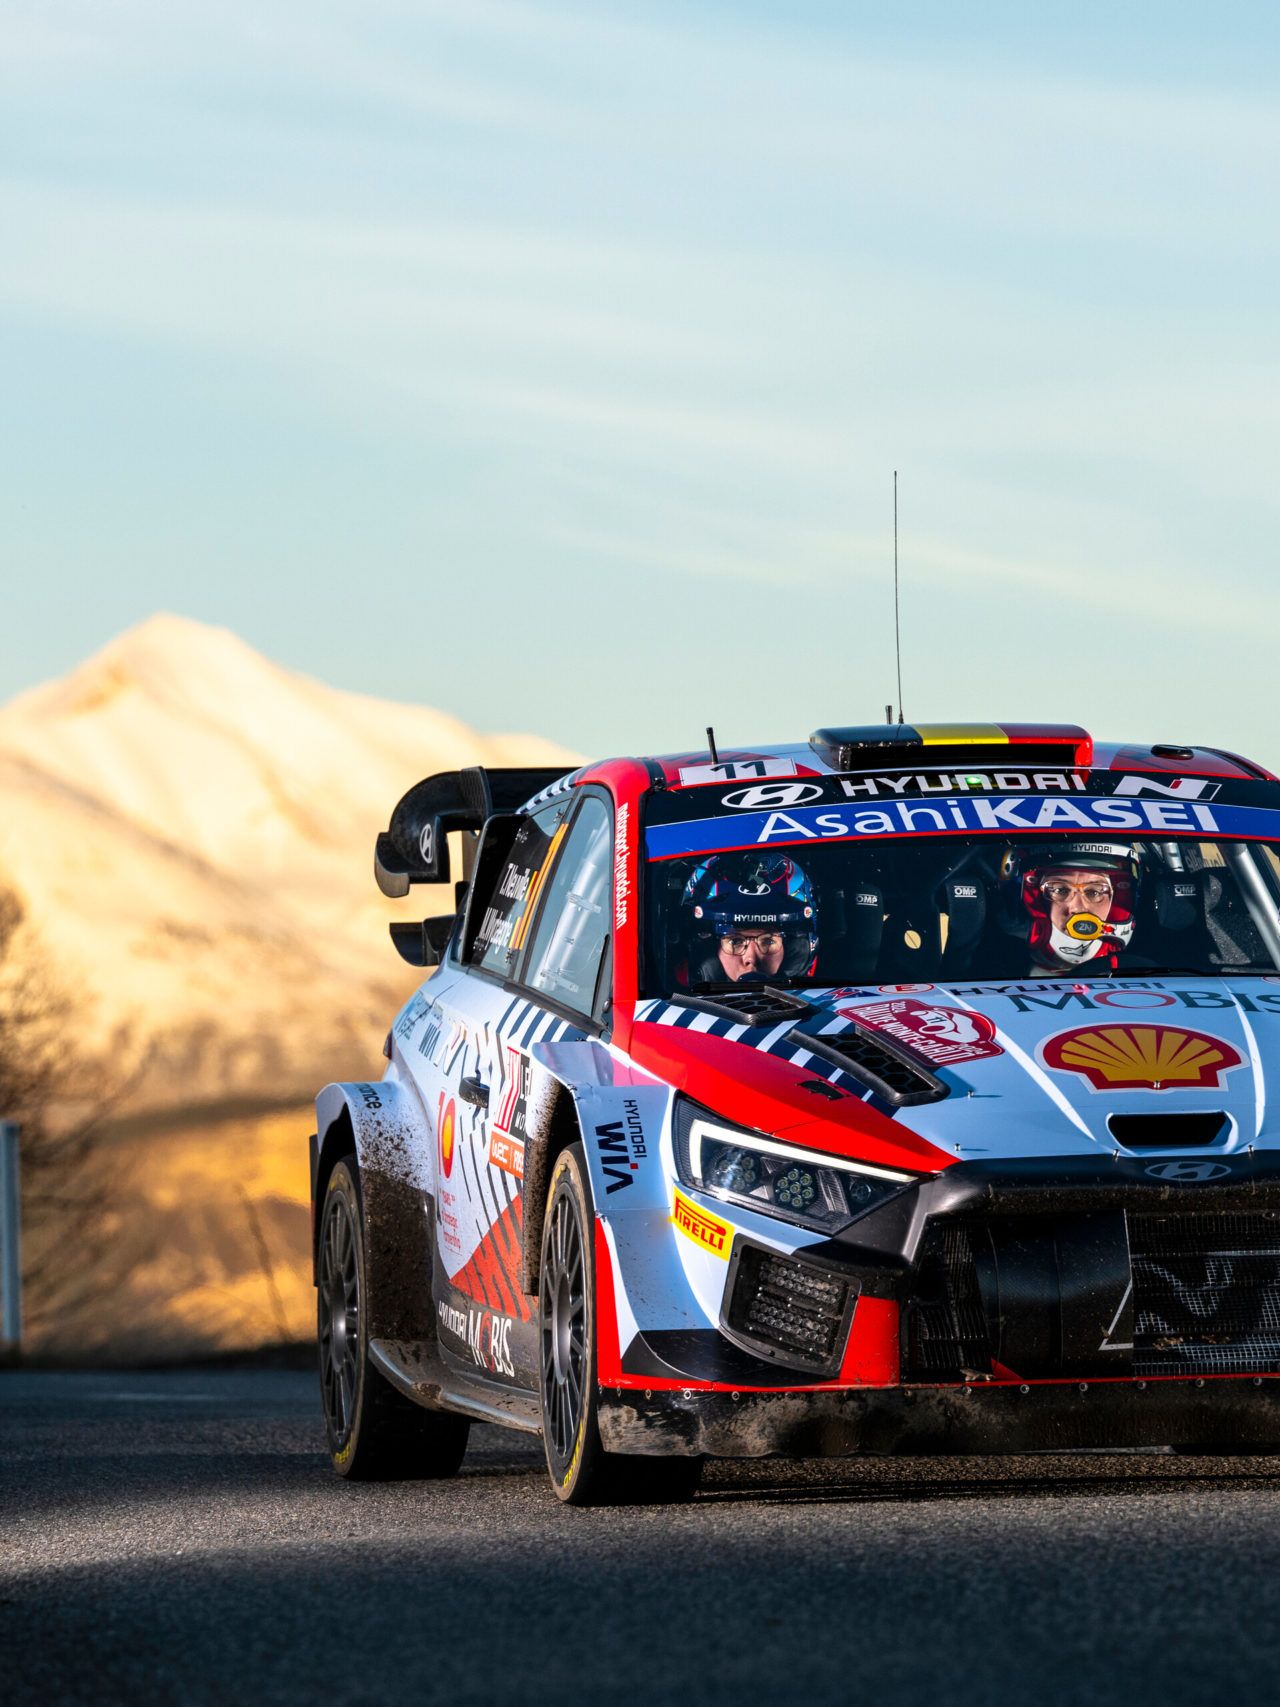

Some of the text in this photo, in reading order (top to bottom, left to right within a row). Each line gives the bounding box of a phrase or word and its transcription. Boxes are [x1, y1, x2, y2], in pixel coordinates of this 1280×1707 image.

[710, 760, 767, 779] 11
[840, 774, 1086, 796] HYUNDAI
[1072, 844, 1112, 853] HYUNDAI
[615, 803, 631, 930] motorsport.hyundai.com
[856, 895, 878, 904] OMP
[955, 888, 977, 896] OMP
[734, 914, 777, 922] HYUNDAI
[950, 982, 1166, 996] HYUNDAI
[624, 1100, 647, 1158] HYUNDAI
[595, 1121, 634, 1195] WIA
[674, 1197, 727, 1251] PIRELLI
